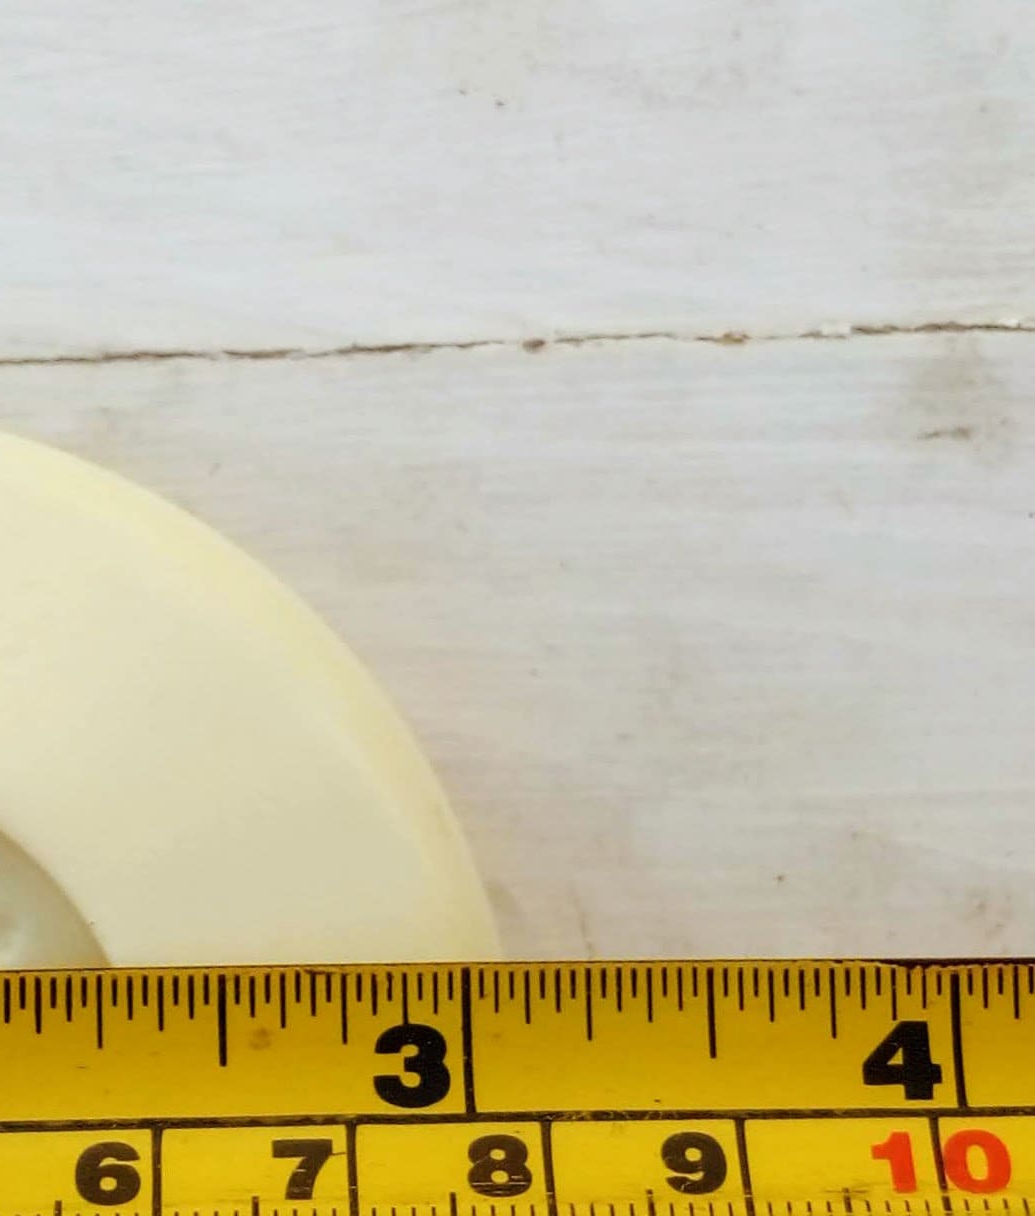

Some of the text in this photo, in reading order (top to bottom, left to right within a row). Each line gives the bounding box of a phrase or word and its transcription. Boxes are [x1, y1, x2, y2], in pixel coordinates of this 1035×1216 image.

[373, 1024, 450, 1108] 3
[863, 1021, 942, 1100] 4
[75, 1141, 141, 1206] 6
[272, 1139, 337, 1200] 7
[468, 1134, 532, 1197] 8
[661, 1132, 727, 1194] 9
[871, 1129, 1011, 1193] 10
